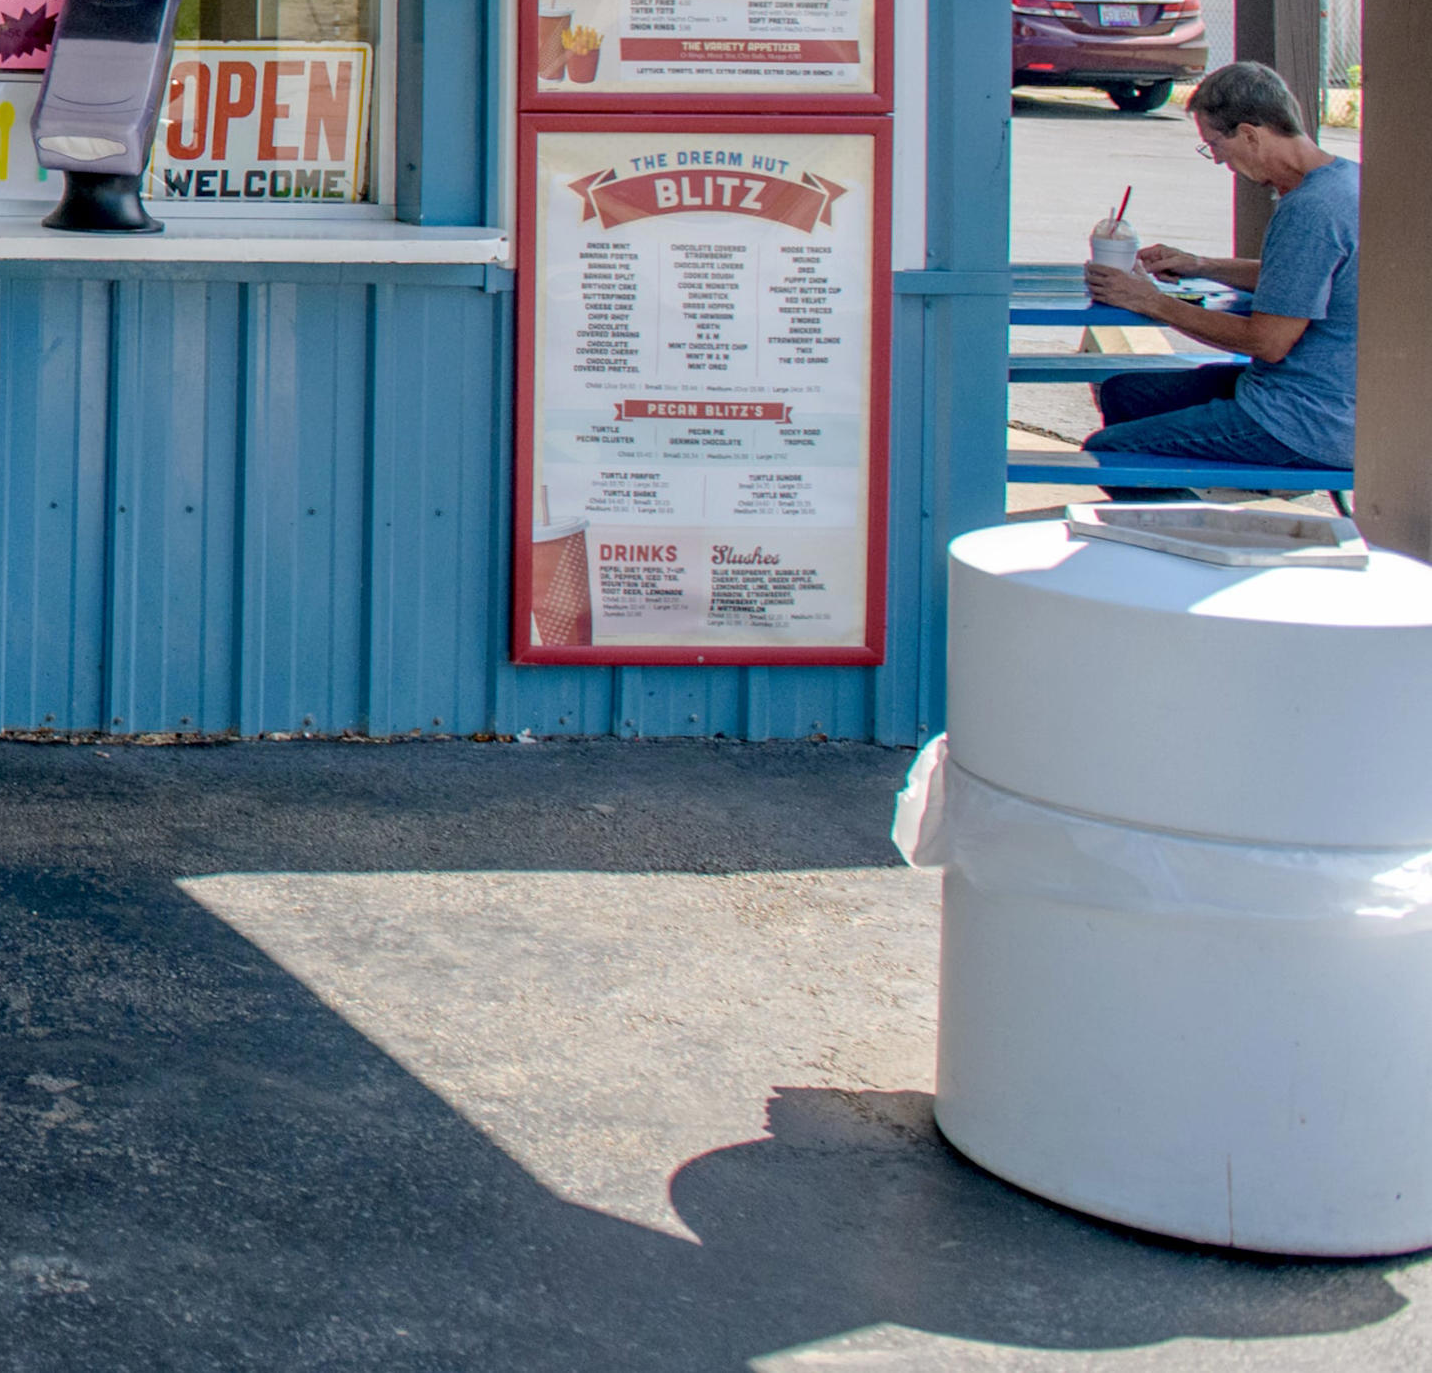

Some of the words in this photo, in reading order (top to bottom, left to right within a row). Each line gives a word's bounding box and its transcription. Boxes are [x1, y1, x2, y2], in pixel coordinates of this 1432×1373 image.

[681, 41, 701, 51] THE
[703, 41, 746, 51] VARIETY
[747, 42, 801, 52] APPETIZER
[166, 60, 353, 161] OPEN
[630, 152, 668, 172] THE
[676, 150, 743, 167] DREAM
[751, 157, 790, 174] HUT
[164, 169, 346, 198] WELCOME
[654, 176, 766, 210] BLITZ
[647, 403, 698, 416] PECAN
[705, 404, 764, 417] BLITZ'S
[599, 544, 678, 562] DRINKS
[711, 544, 781, 566] Slushes
